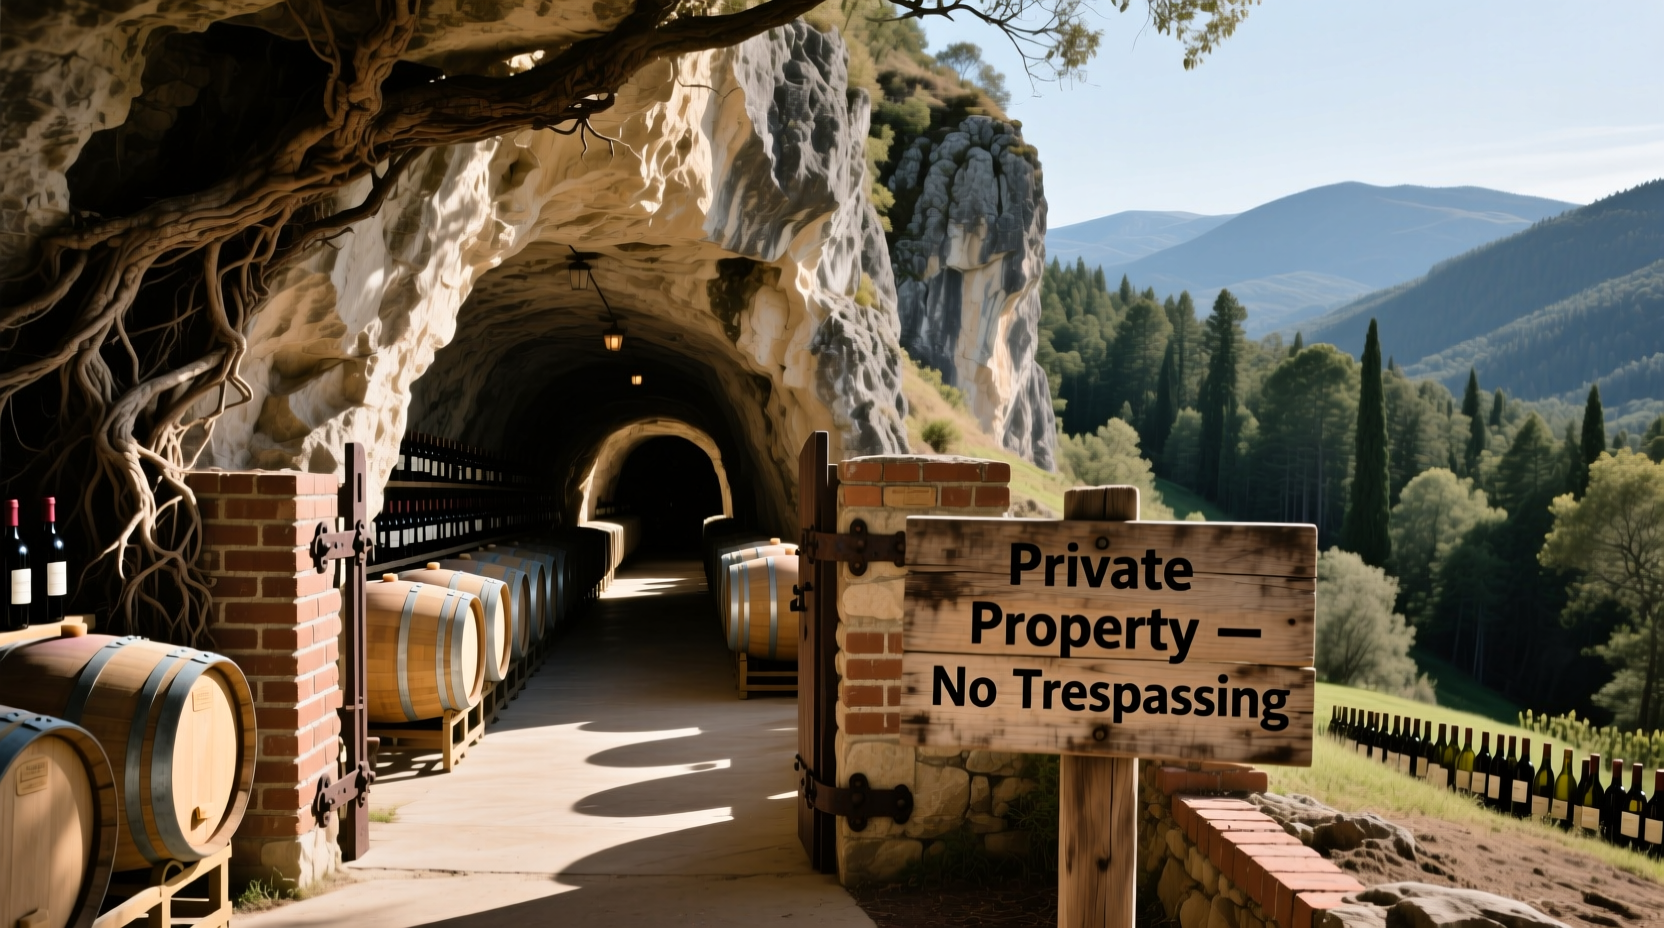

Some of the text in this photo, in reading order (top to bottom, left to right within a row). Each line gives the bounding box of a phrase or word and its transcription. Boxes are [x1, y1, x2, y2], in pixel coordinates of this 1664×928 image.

[1010, 542, 1194, 592] Private
[971, 600, 1200, 665] Property
[932, 665, 1291, 732] No Trespassing
